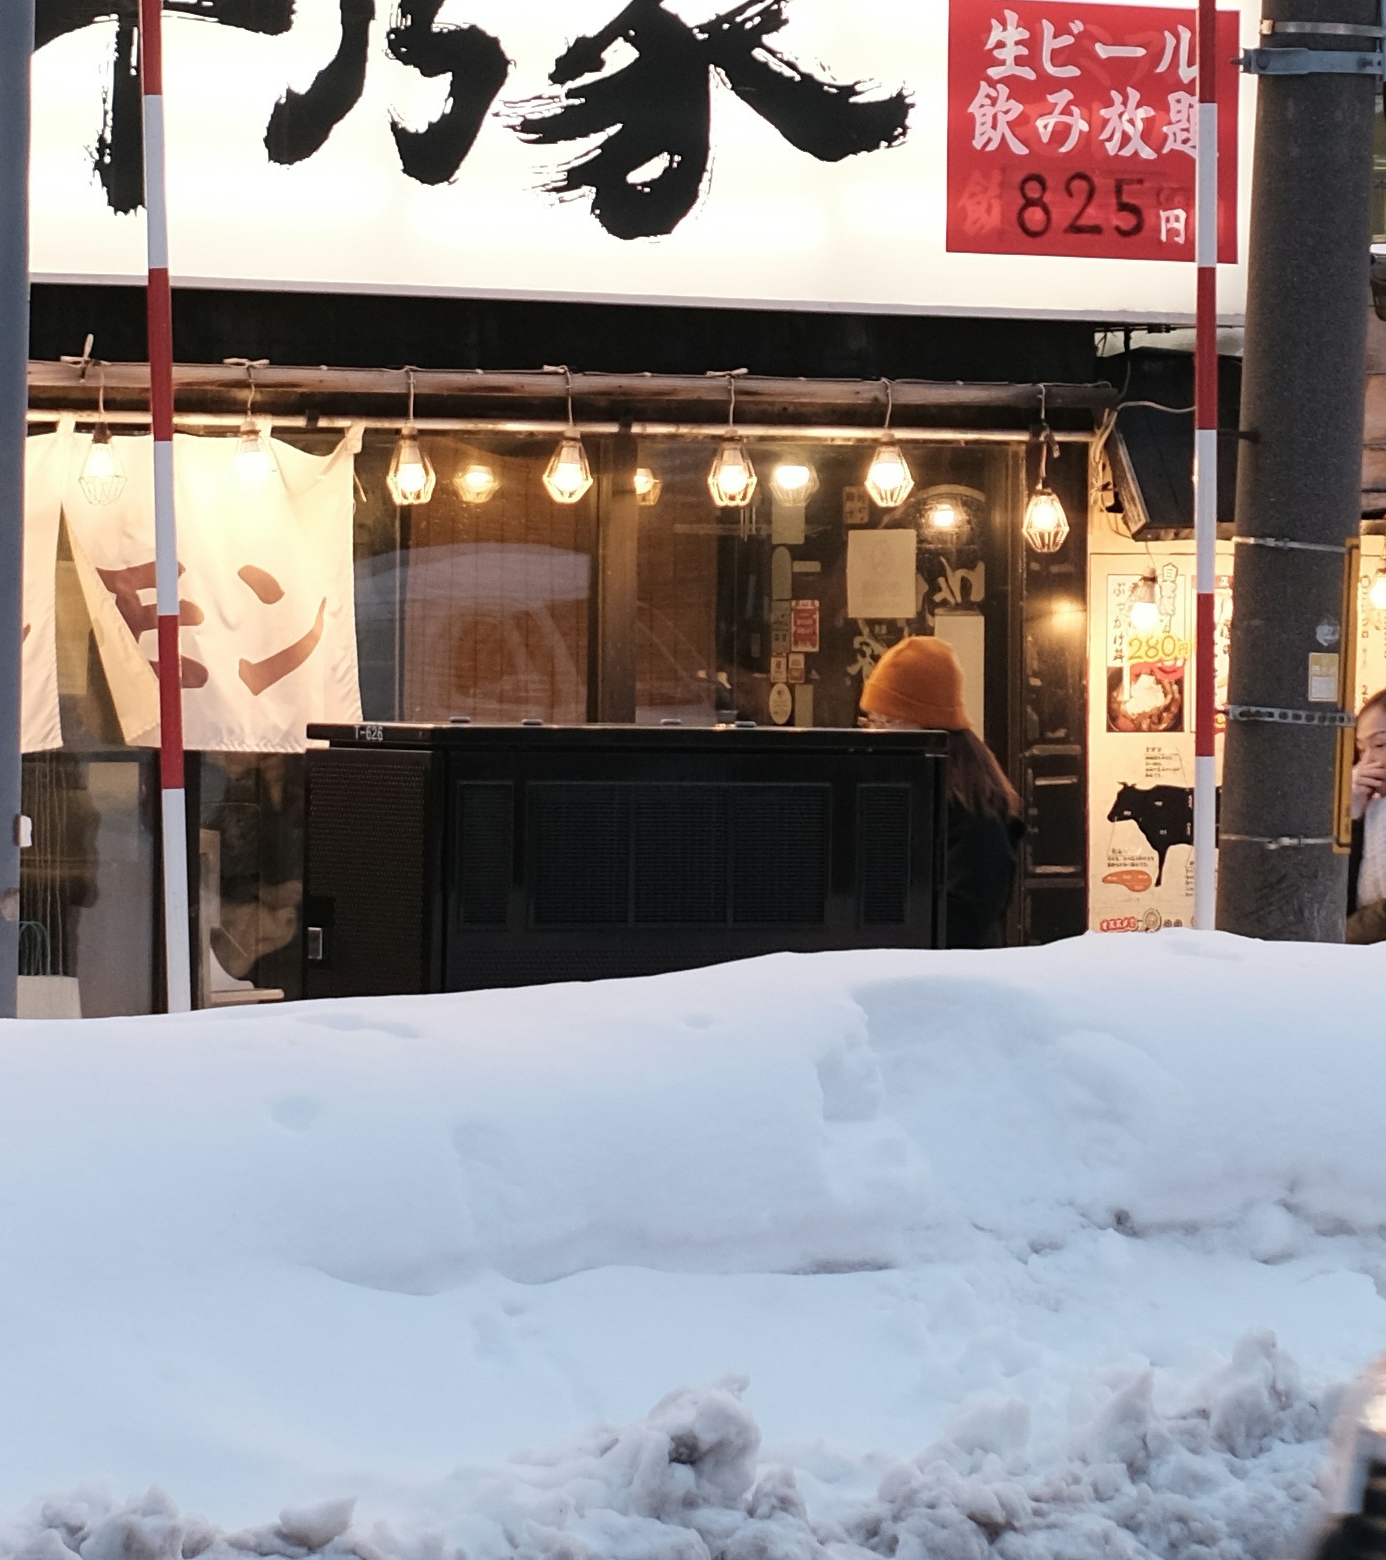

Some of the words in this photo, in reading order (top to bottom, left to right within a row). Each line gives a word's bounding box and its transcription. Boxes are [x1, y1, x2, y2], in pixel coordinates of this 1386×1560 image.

[982, 9, 1199, 83] 生ビール
[967, 80, 1213, 160] 飲み放題
